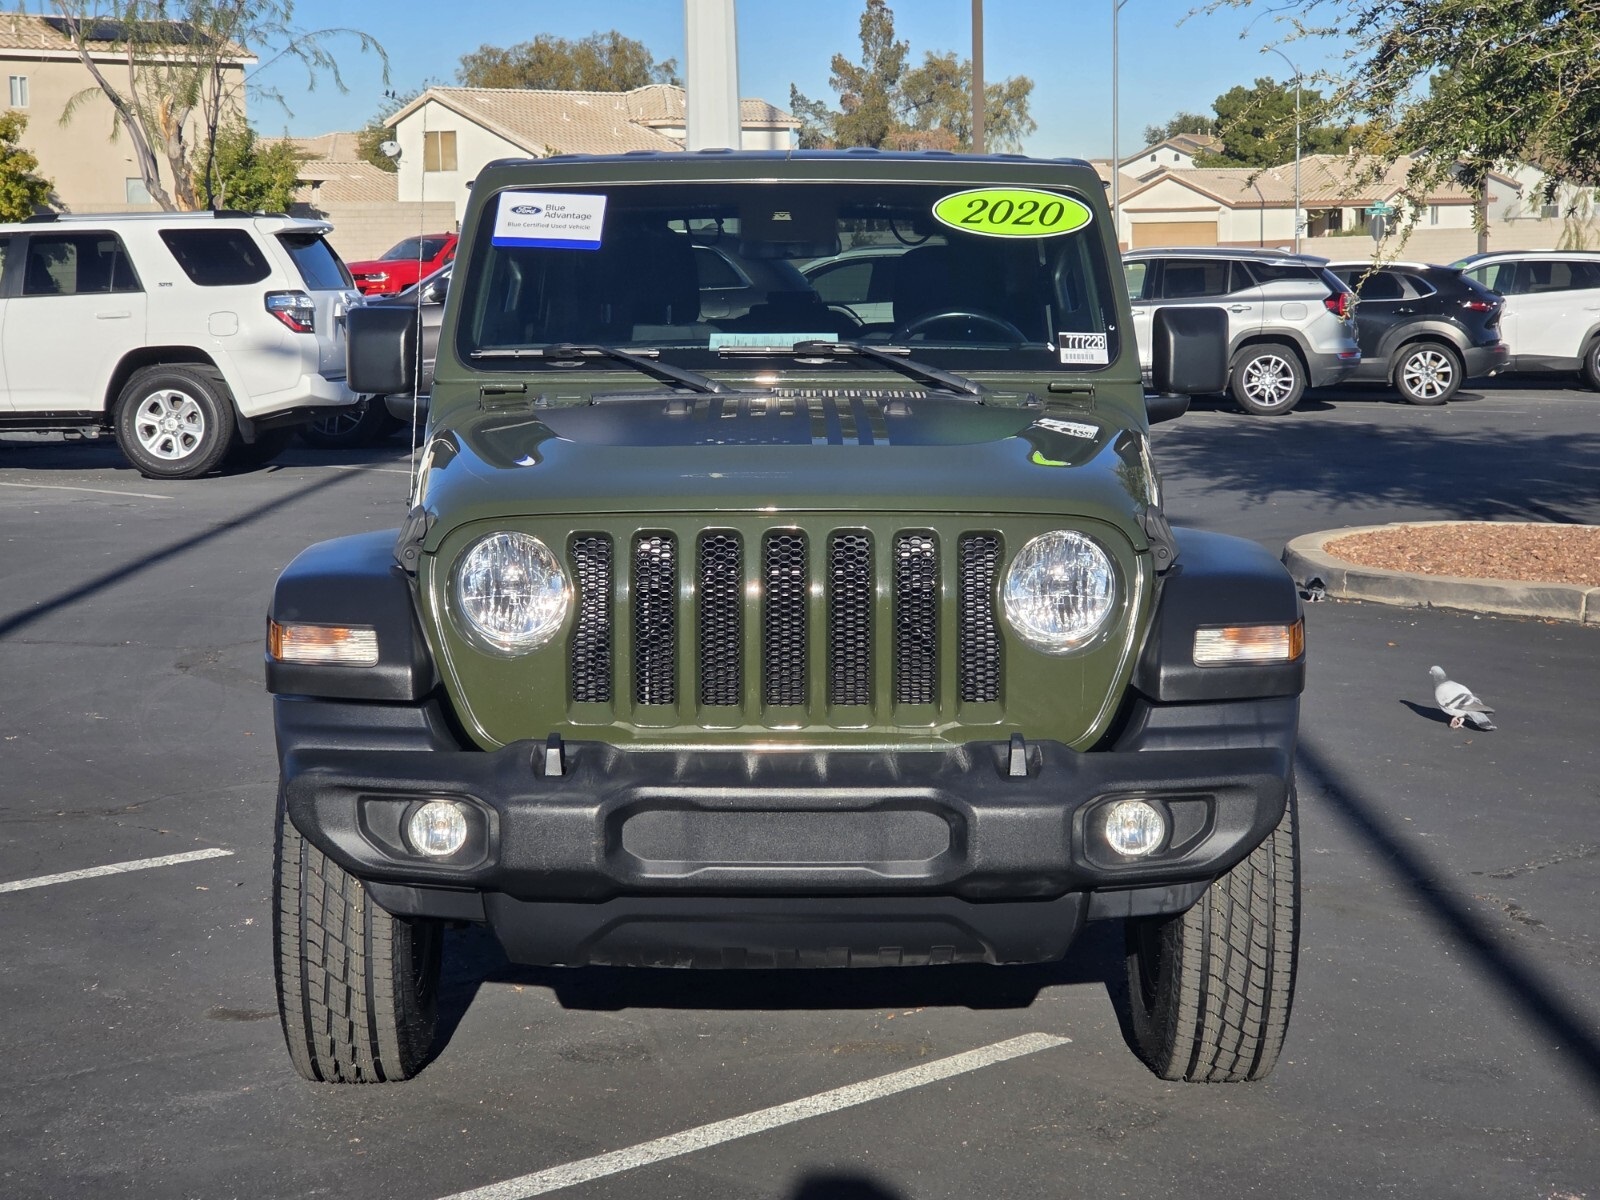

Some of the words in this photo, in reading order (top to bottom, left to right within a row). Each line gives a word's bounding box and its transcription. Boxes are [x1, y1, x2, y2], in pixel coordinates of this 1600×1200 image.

[514, 205, 537, 215] Ford
[545, 204, 566, 212] Blue
[544, 211, 592, 220] Advantage
[960, 199, 1065, 227] 2020
